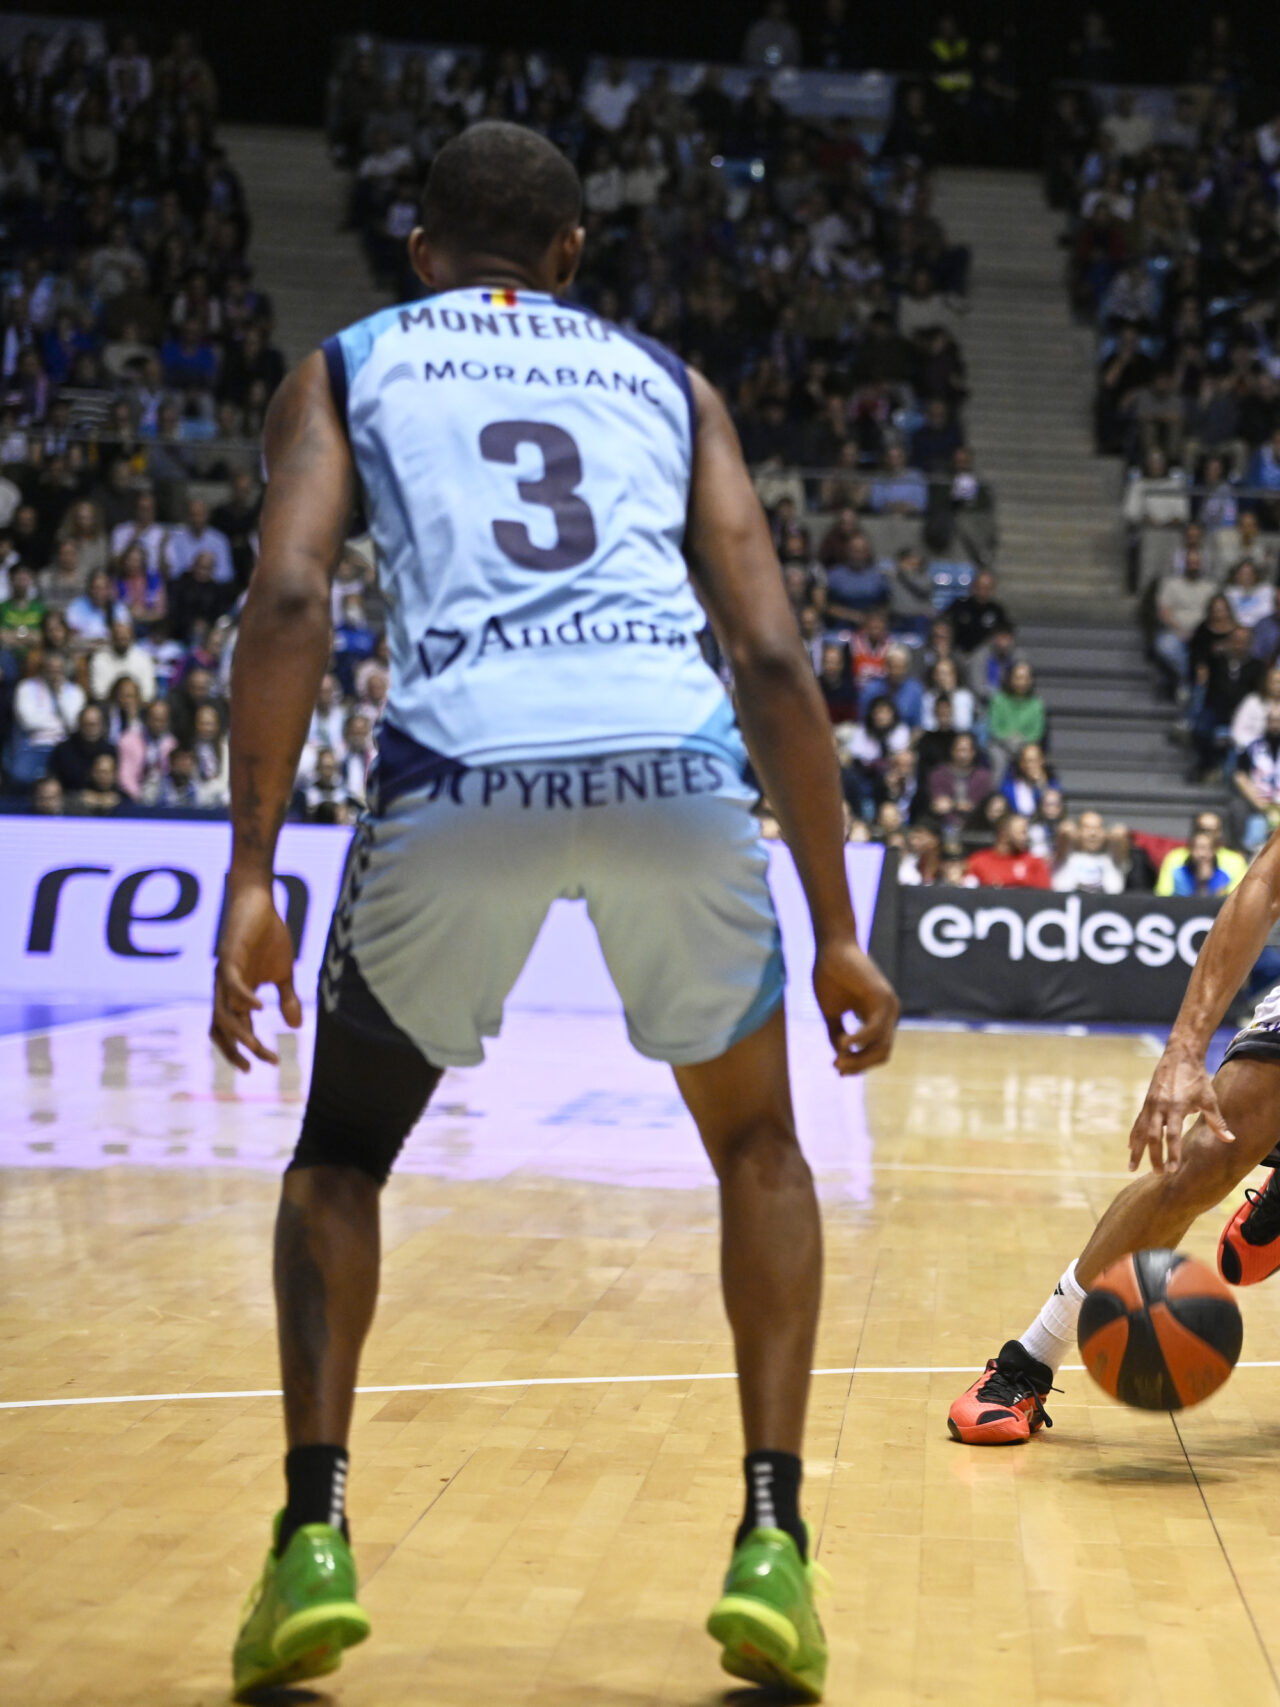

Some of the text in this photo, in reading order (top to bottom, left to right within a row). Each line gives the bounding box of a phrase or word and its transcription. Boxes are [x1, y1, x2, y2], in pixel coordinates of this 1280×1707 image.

[398, 306, 613, 342] MONTERO
[424, 361, 664, 405] MORABANC
[478, 420, 598, 572] 3
